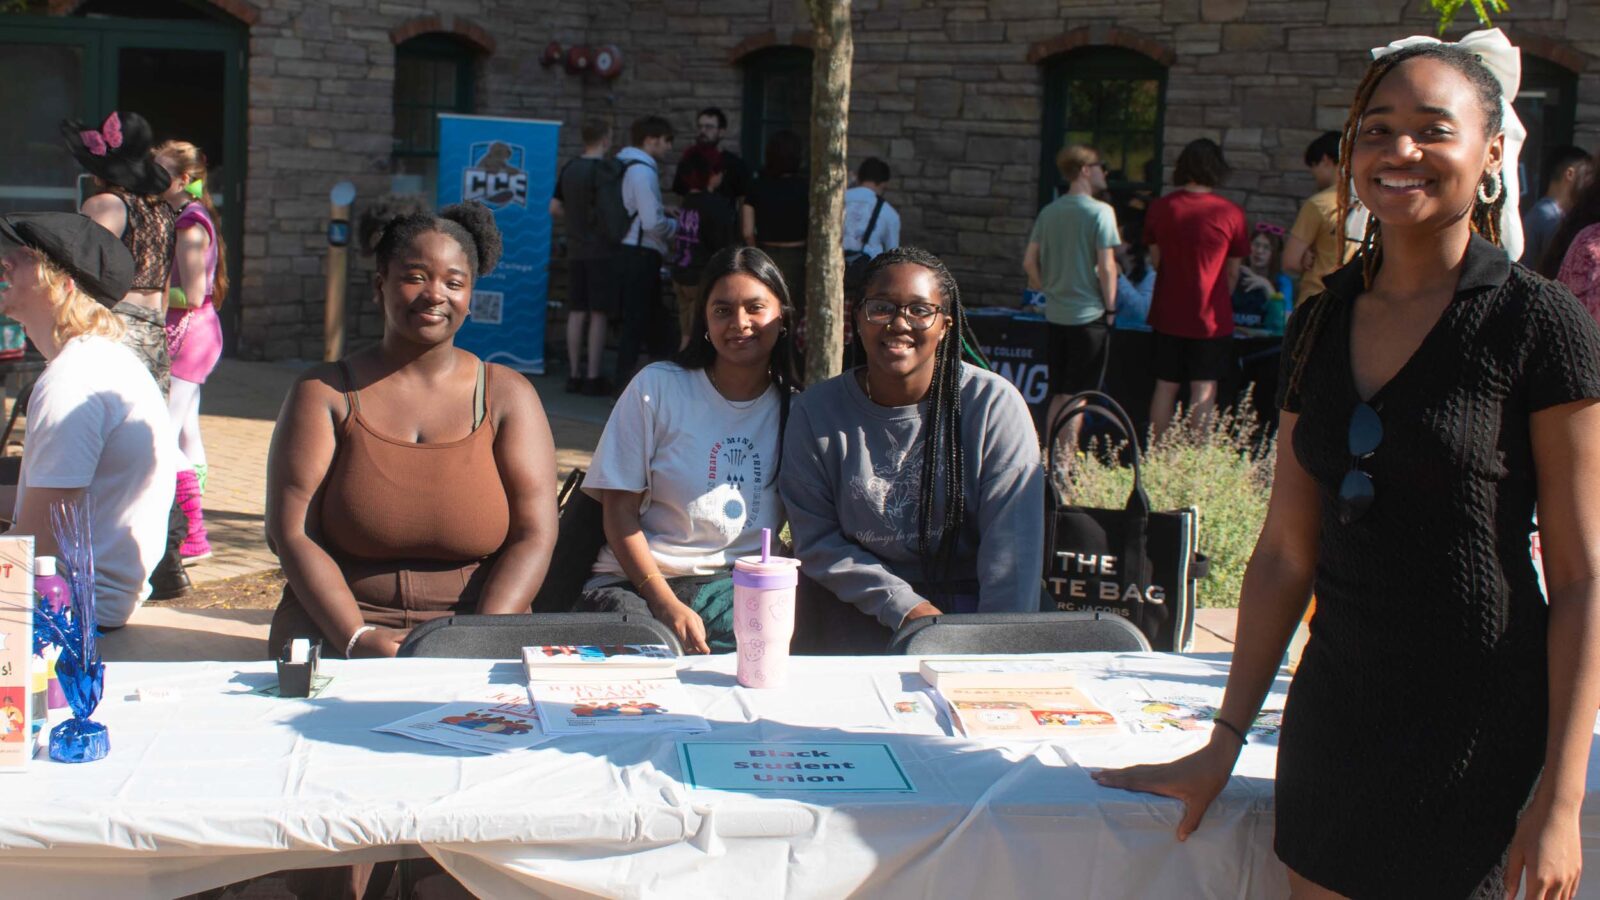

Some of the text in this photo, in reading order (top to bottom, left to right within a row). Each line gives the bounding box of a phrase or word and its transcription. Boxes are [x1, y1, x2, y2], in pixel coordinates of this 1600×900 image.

[499, 261, 533, 273] College
[994, 346, 1033, 358] COLLEGE
[726, 437, 754, 450] MIND
[752, 453, 761, 483] TRIPS
[856, 529, 894, 545] Always
[1056, 551, 1118, 575] THE
[1050, 577, 1166, 604] TE BAG
[1077, 604, 1130, 617] JACOBS
[749, 749, 831, 759] Black
[733, 761, 856, 770] Student
[753, 774, 845, 783] Union
